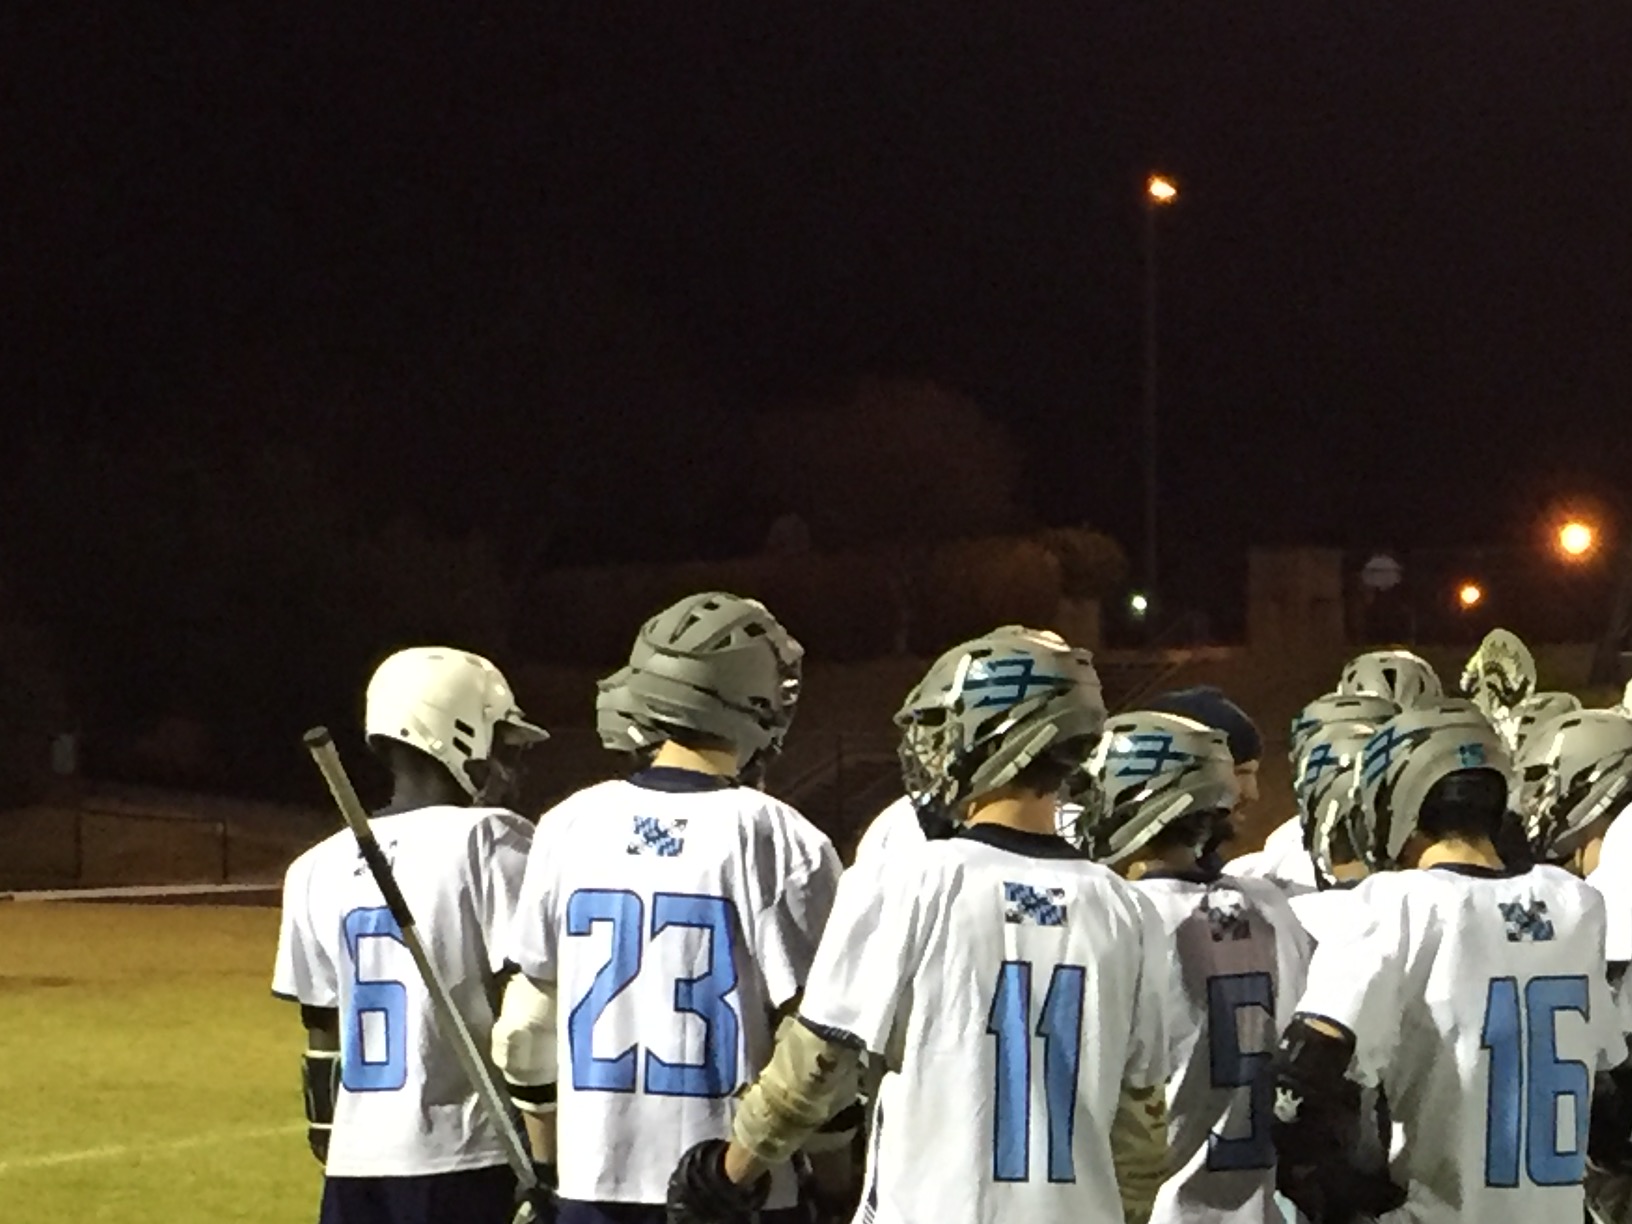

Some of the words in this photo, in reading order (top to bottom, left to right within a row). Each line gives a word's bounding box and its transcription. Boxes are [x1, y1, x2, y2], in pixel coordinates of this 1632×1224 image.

[341, 906, 409, 1091] 6
[567, 888, 738, 1097] 23
[986, 961, 1086, 1183] 11
[1207, 972, 1277, 1171] 5
[1480, 975, 1590, 1187] 16
